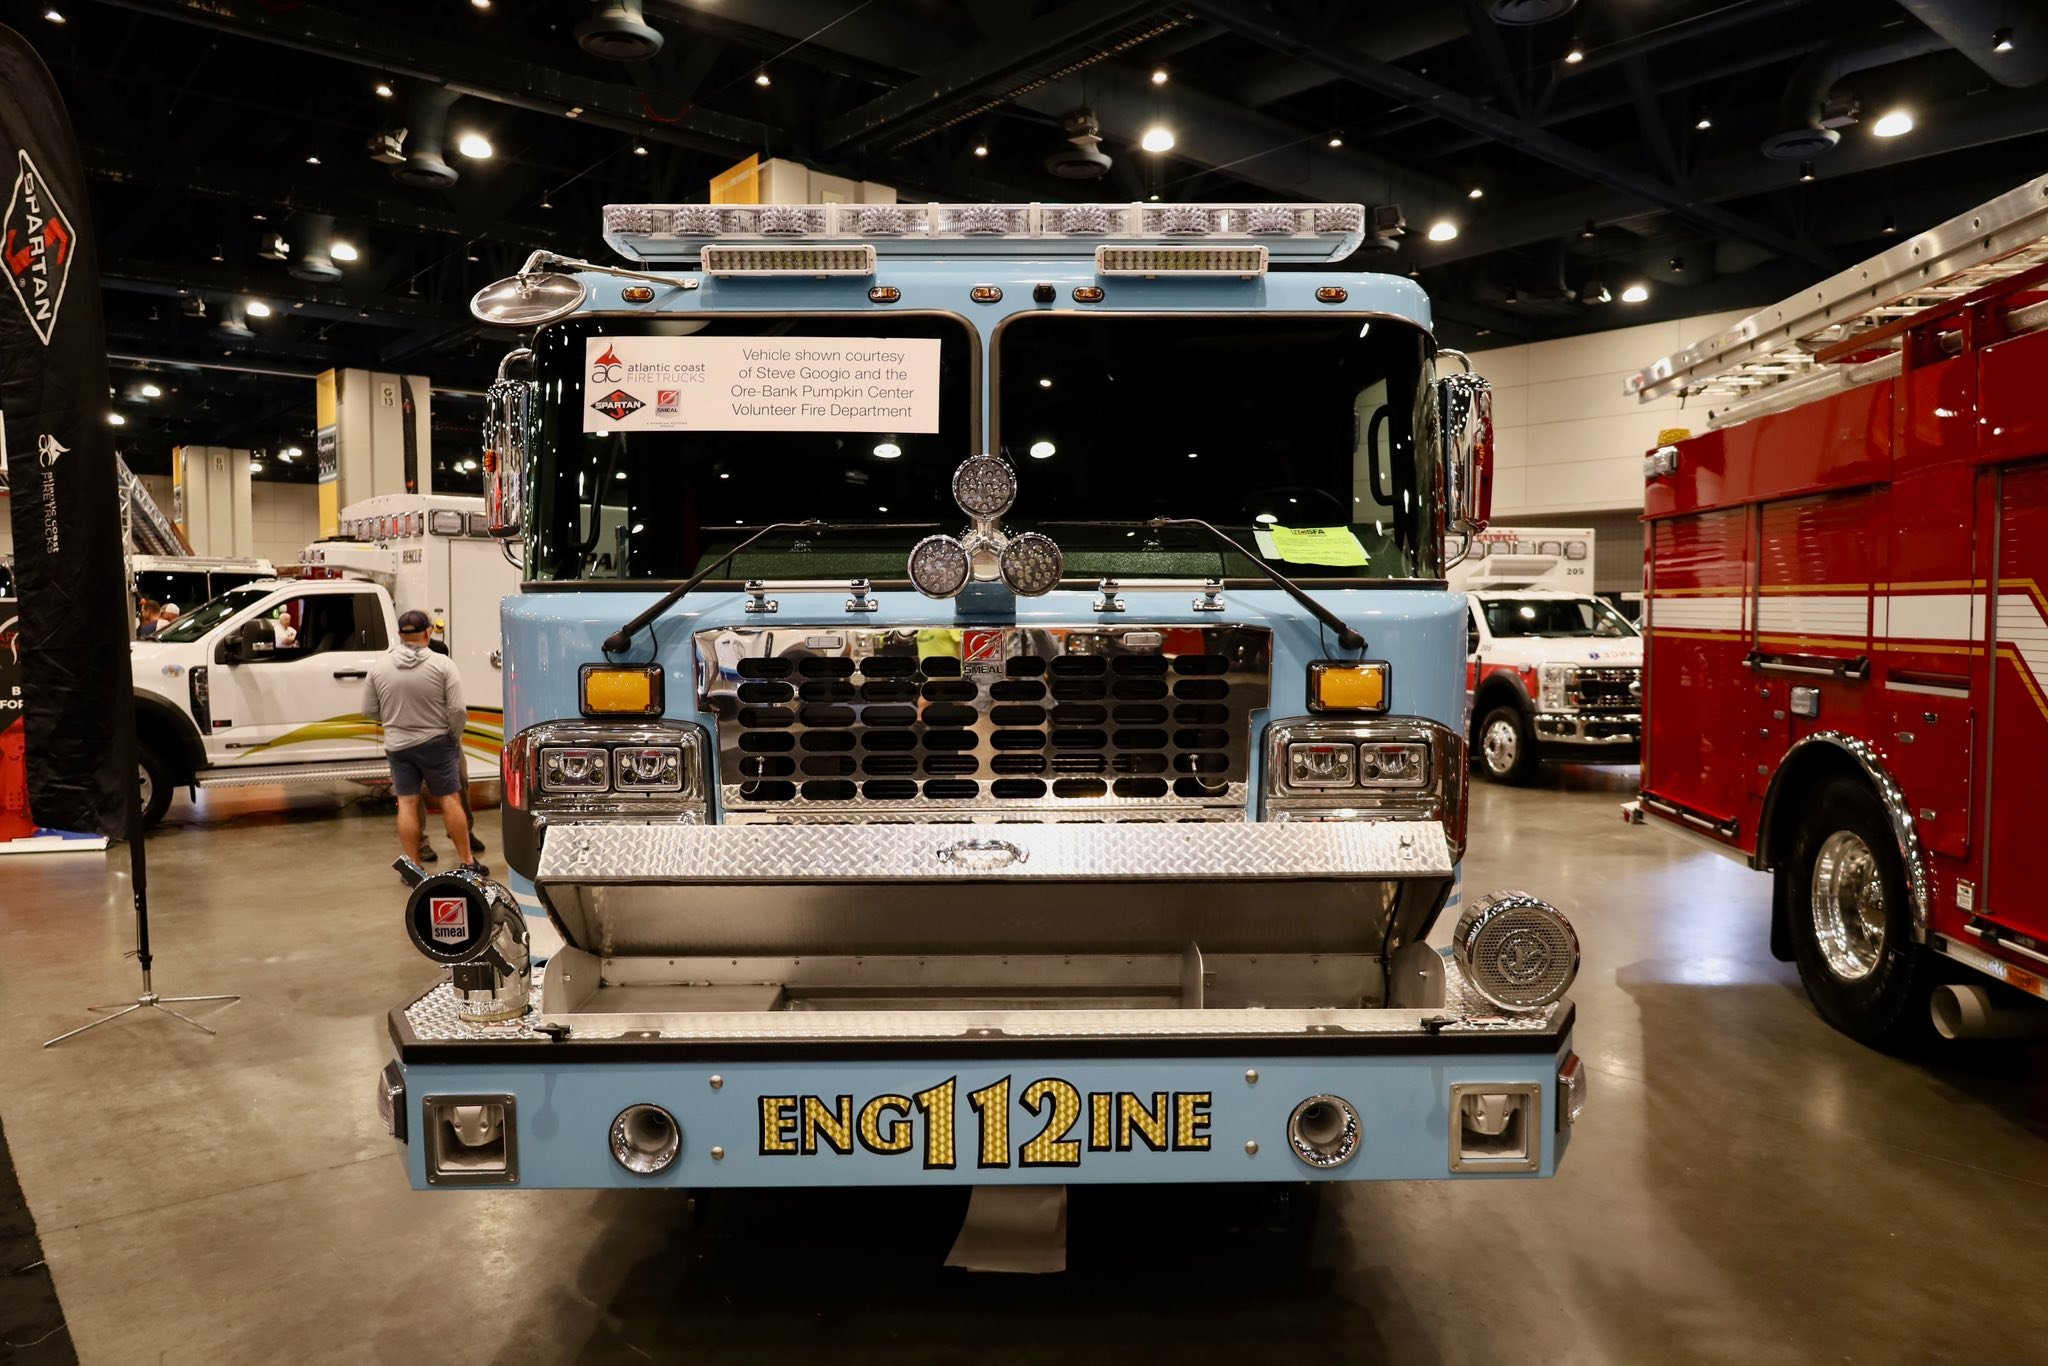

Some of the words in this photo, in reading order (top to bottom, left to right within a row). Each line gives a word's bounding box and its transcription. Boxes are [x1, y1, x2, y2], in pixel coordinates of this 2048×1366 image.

[23, 172, 52, 321] SPARTAN
[742, 349, 791, 361] Vehicle
[795, 349, 841, 361] shown
[845, 350, 905, 364] courtesy
[627, 362, 671, 372] atlantic
[674, 363, 705, 372] coast
[626, 372, 705, 383] FIRETRUCKS
[738, 366, 753, 379] of
[756, 366, 796, 379] Steve
[799, 366, 851, 382] Googio
[854, 368, 881, 380] and
[886, 368, 908, 381] the
[384, 387, 393, 396] G
[730, 384, 798, 398] Ore-Bank
[802, 385, 863, 400] Pumpkin
[867, 386, 915, 399] Center
[384, 397, 394, 406] 13
[594, 401, 641, 410] SPARTAN
[731, 403, 797, 416] Volunteer
[801, 403, 826, 416] Fire
[830, 404, 912, 419] Department
[40, 472, 54, 554] FIRETRUCKS
[51, 519, 60, 553] coast
[1566, 567, 1584, 575] 205
[964, 665, 1003, 674] SMEAL
[434, 926, 466, 938] smeal
